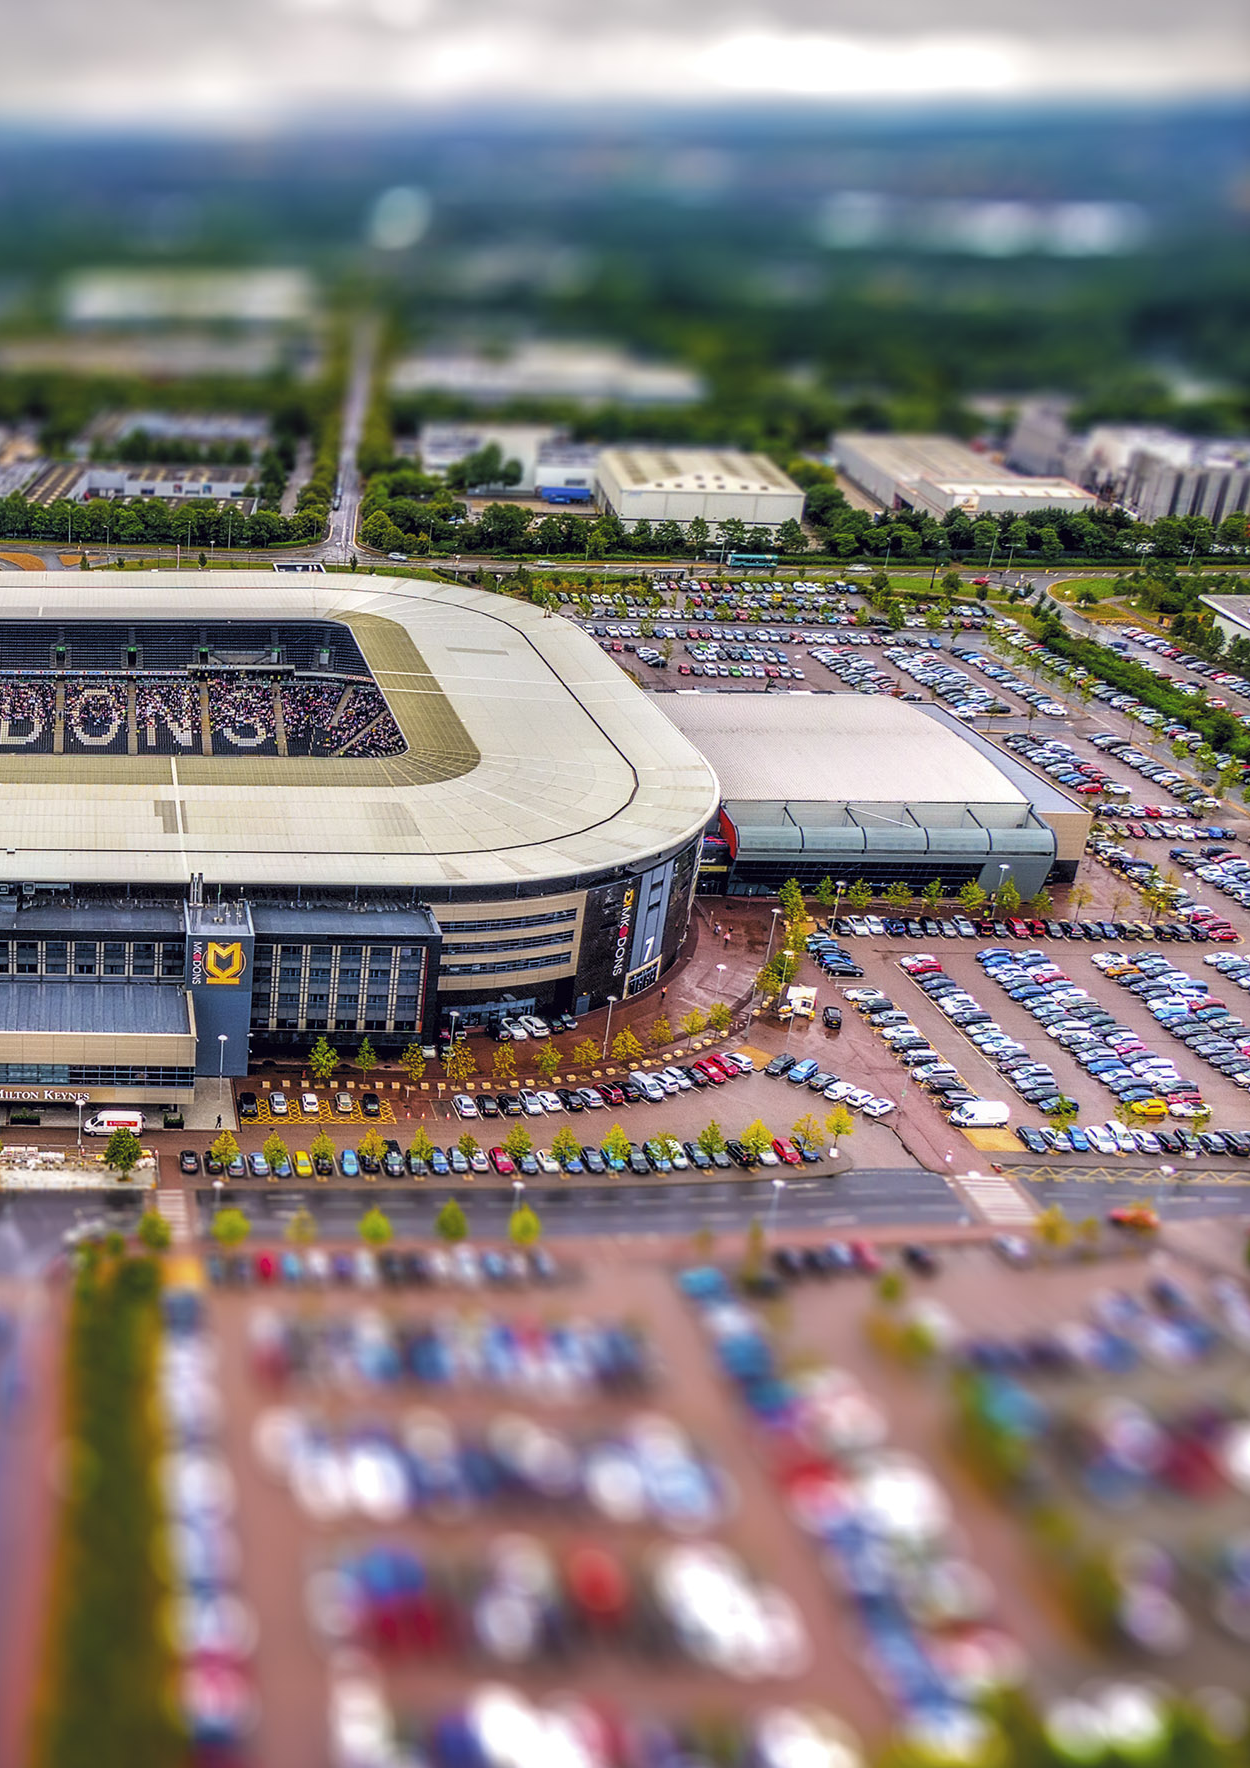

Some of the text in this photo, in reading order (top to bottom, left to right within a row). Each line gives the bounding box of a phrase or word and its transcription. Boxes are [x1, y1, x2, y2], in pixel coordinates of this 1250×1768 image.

[643, 936, 655, 962] 1
[192, 960, 202, 985] DONS
[43, 1089, 90, 1101] KEYNES
